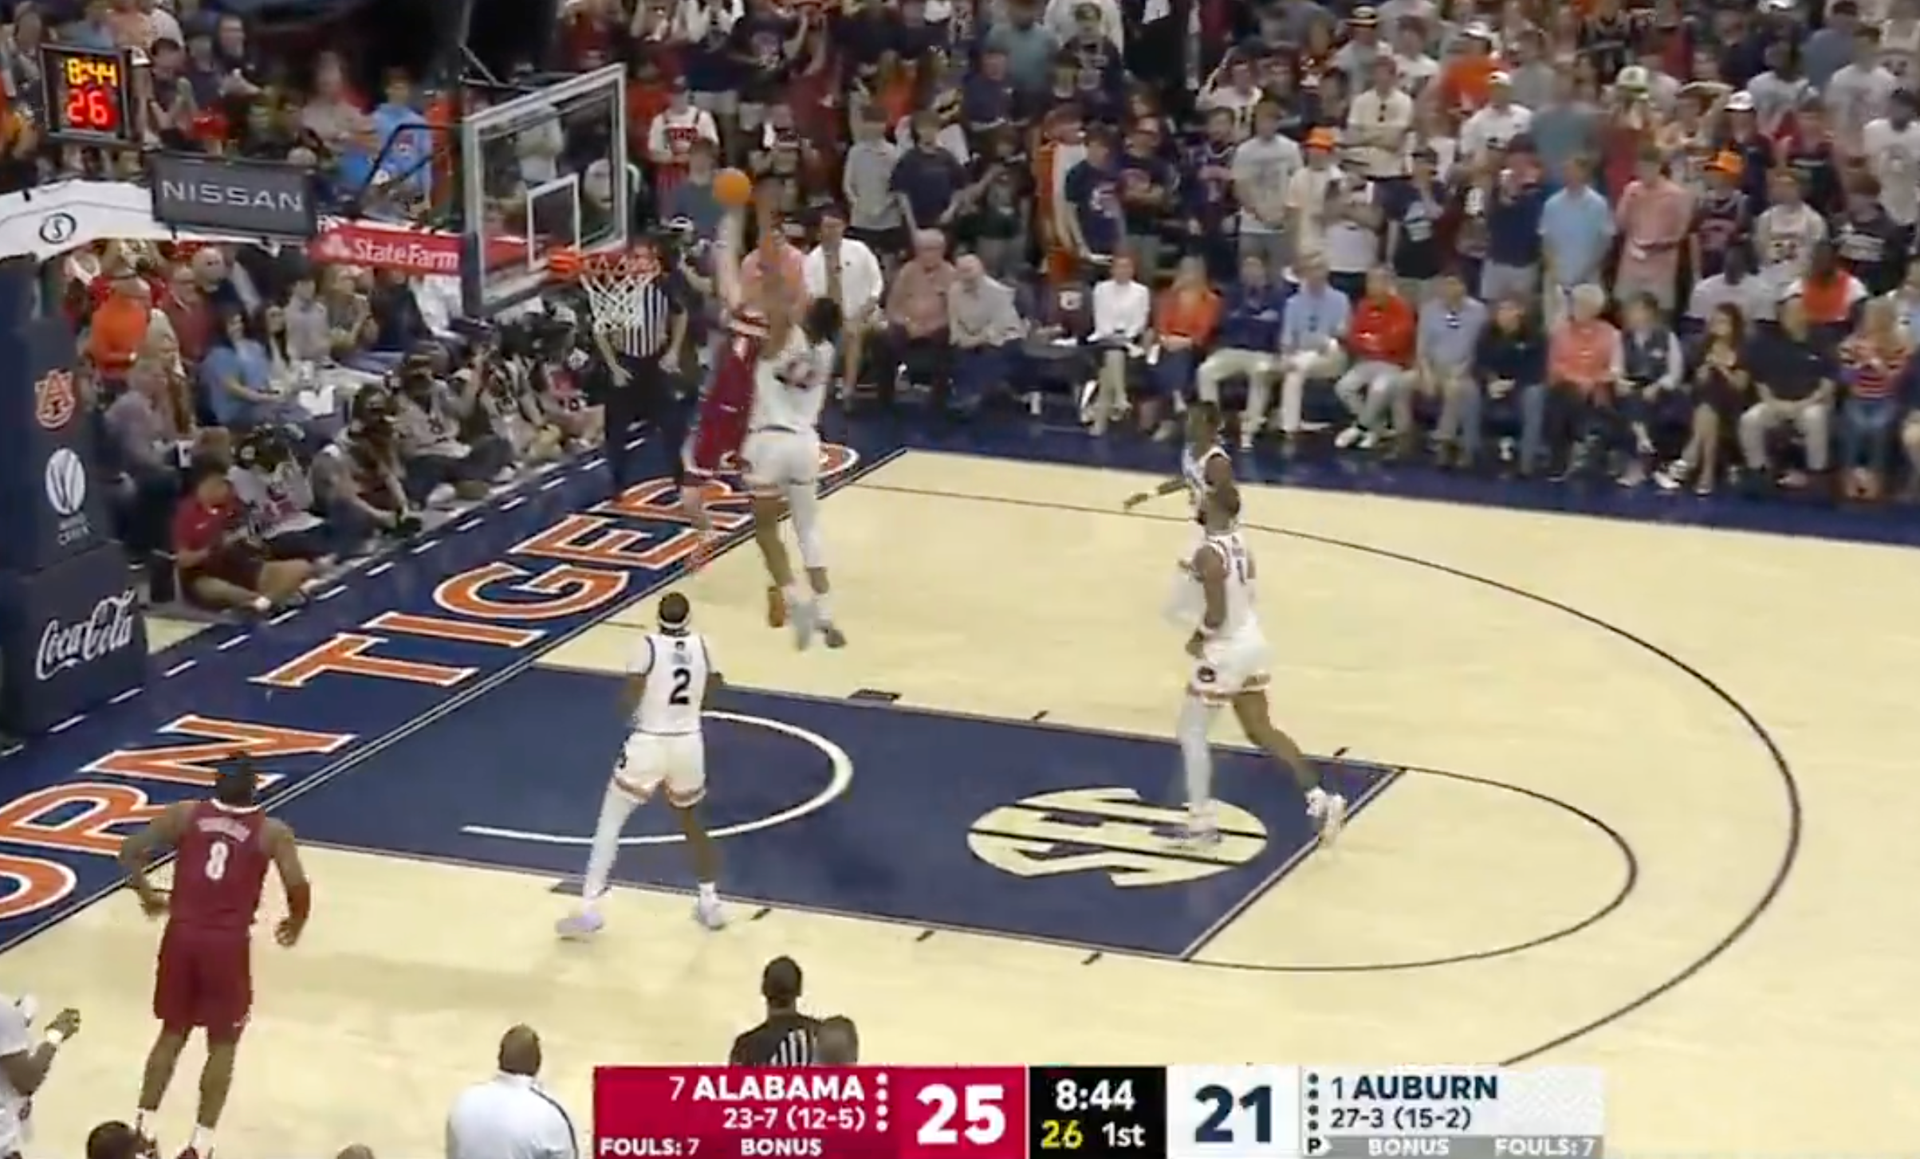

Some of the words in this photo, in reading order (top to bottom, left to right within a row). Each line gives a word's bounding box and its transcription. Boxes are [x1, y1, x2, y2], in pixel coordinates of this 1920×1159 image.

[67, 58, 118, 87] 8:44
[67, 88, 108, 124] 26
[161, 180, 303, 213] NISSAN
[668, 668, 691, 705] 2
[205, 841, 229, 881] 8
